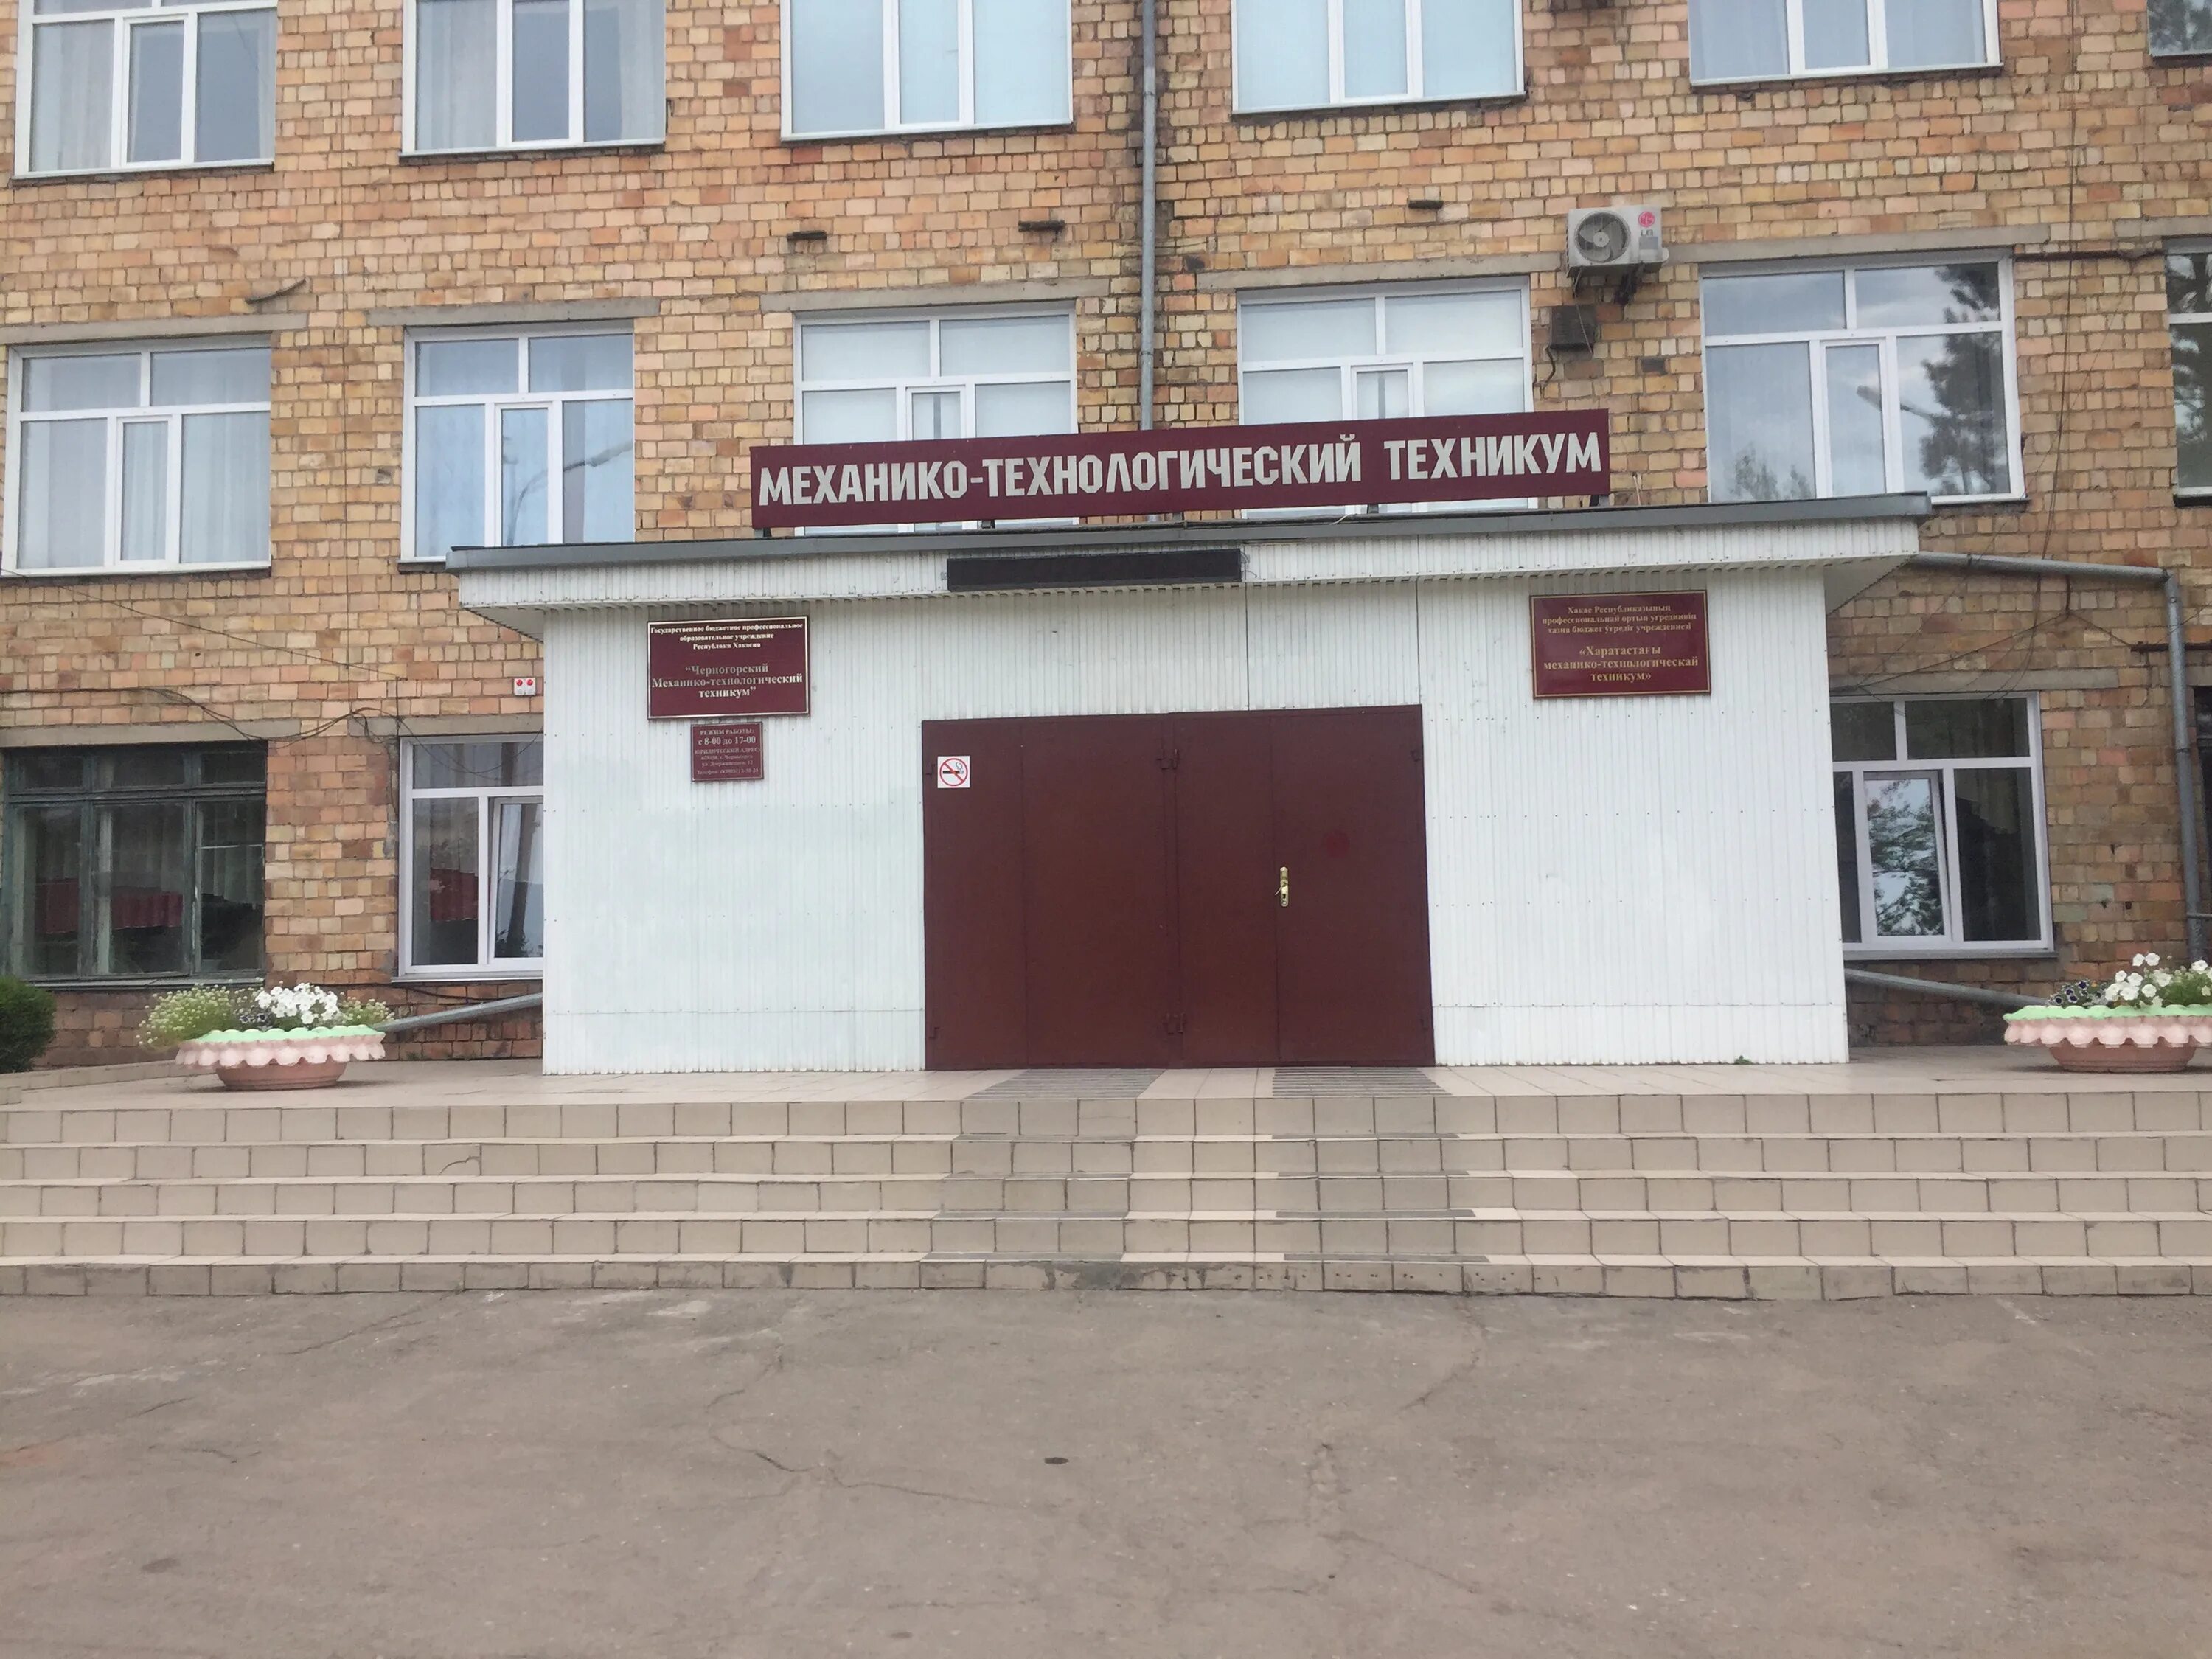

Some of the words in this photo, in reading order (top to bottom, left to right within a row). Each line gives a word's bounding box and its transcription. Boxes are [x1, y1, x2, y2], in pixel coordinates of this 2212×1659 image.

[759, 434, 1361, 506] МЕХАНИКО-ТЕХНОЛОГИЧЕСКИЙ
[1384, 432, 1601, 480] ТЕХНИКУМ
[1568, 606, 1593, 614] Хакас
[650, 627, 704, 635] Государственное
[742, 623, 804, 632] профессиональное
[651, 673, 803, 688] Механико-технологический
[704, 737, 721, 745] 8-00
[734, 736, 756, 744] 17-00
